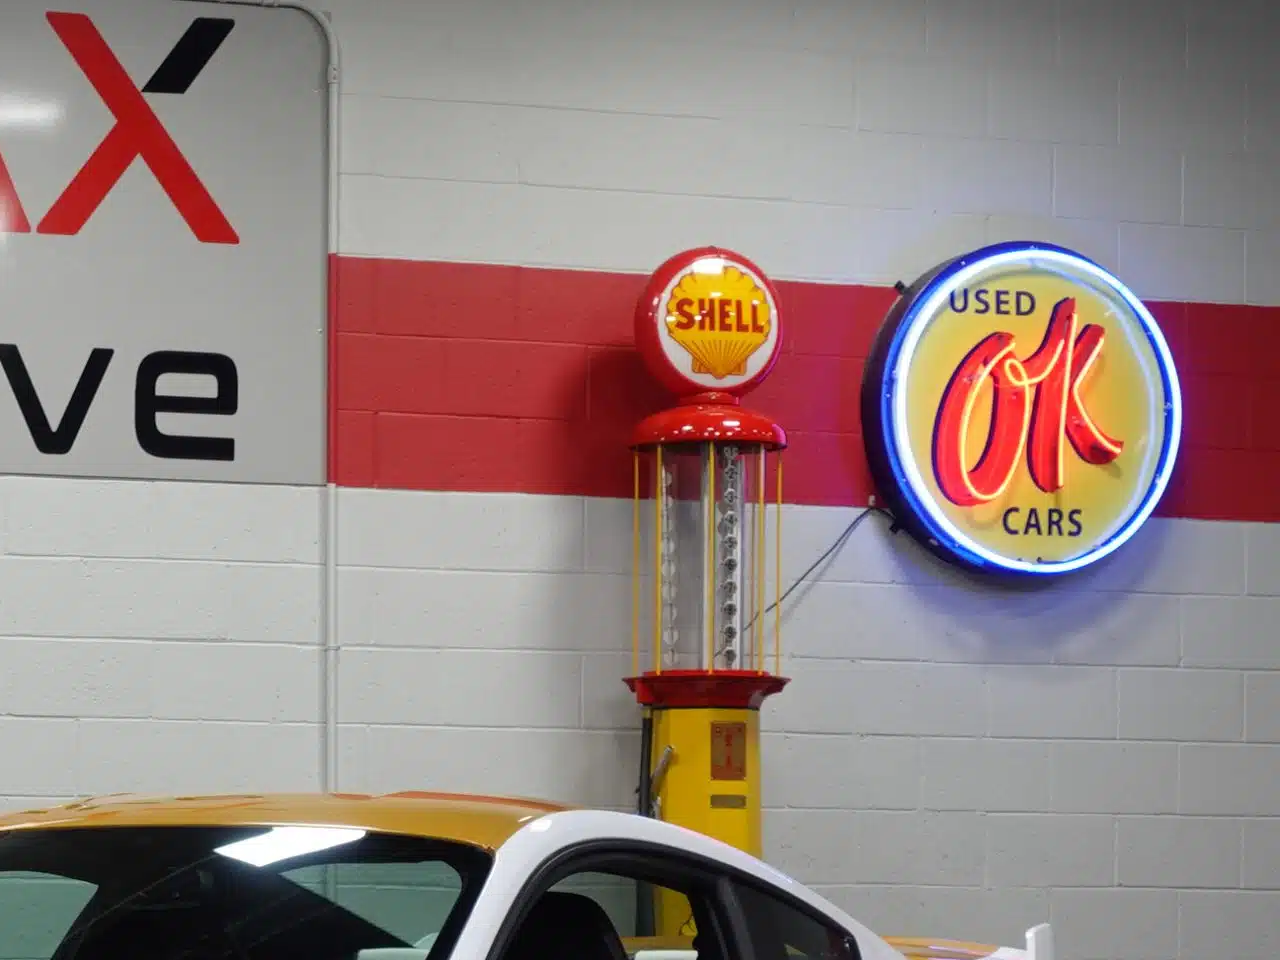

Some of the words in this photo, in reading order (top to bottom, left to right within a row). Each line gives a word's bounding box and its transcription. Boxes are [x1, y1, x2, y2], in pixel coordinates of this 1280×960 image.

[675, 298, 765, 333] SHELL
[949, 288, 1036, 316] USED
[931, 297, 1124, 507] OK
[1002, 506, 1082, 536] CARS
